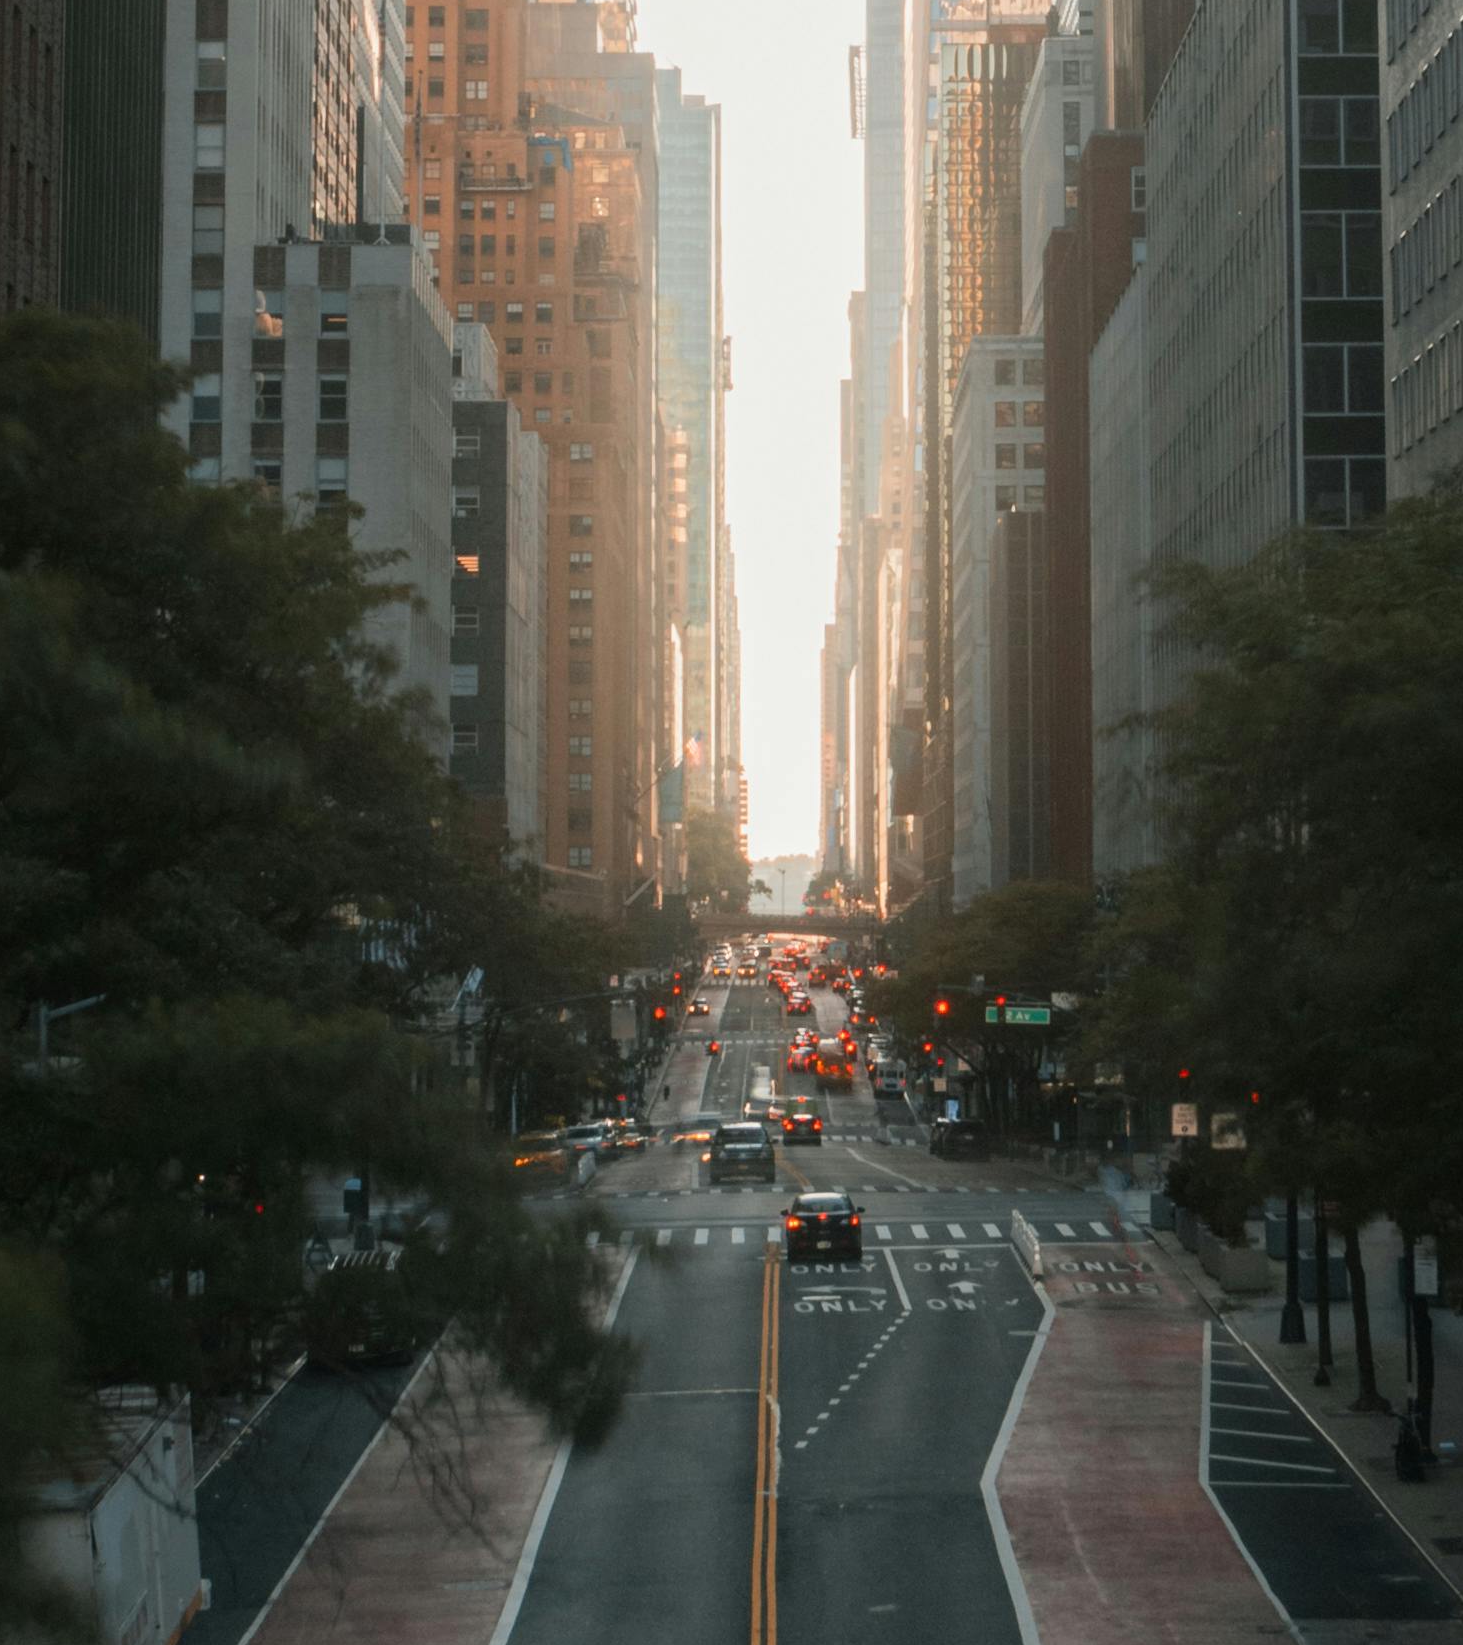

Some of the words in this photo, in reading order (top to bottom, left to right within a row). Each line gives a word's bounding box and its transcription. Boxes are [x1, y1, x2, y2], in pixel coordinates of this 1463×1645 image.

[1016, 1011, 1031, 1021] Av
[791, 1262, 878, 1274] ONLY
[1059, 1261, 1143, 1272] ONLY
[1076, 1282, 1158, 1294] BUS
[794, 1299, 888, 1313] ONLY
